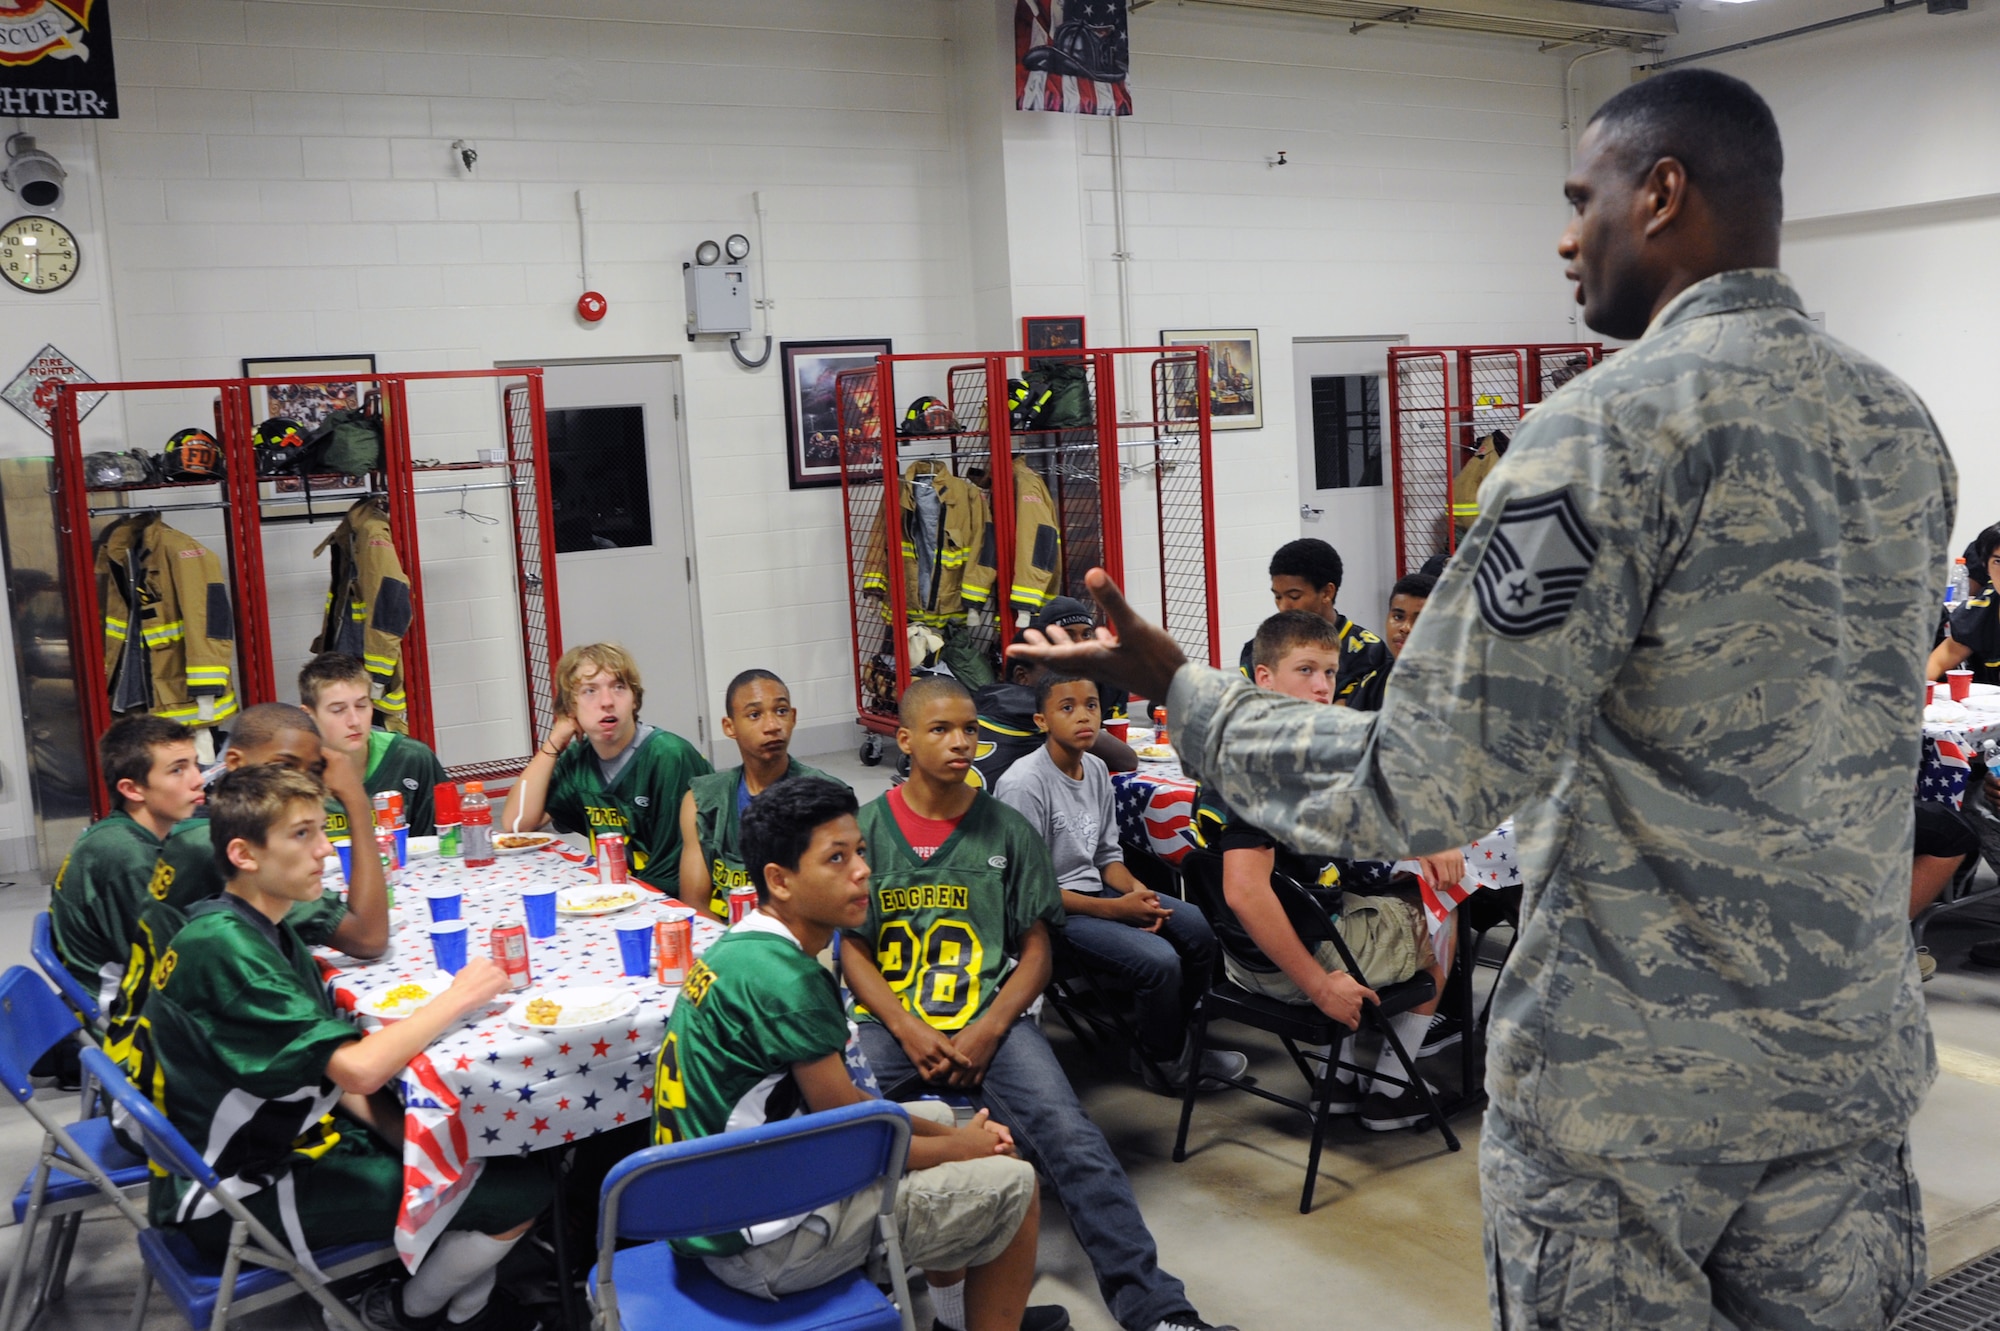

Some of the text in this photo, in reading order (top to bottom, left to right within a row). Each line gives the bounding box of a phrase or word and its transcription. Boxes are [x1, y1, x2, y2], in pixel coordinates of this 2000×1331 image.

[0, 87, 104, 116] HTER
[18, 226, 27, 234] 11
[31, 223, 43, 232] 12
[51, 228, 54, 236] 1
[7, 237, 19, 246] 10
[59, 238, 67, 246] 2
[4, 249, 13, 258] 9
[63, 250, 72, 259] 3
[10, 262, 19, 271] 8
[59, 264, 67, 272] 4
[36, 276, 44, 284] 6
[49, 273, 57, 281] 5
[29, 367, 75, 376] FIGHTER
[187, 448, 212, 464] FD
[878, 884, 969, 912] EDGREN
[862, 919, 984, 1030] 28
